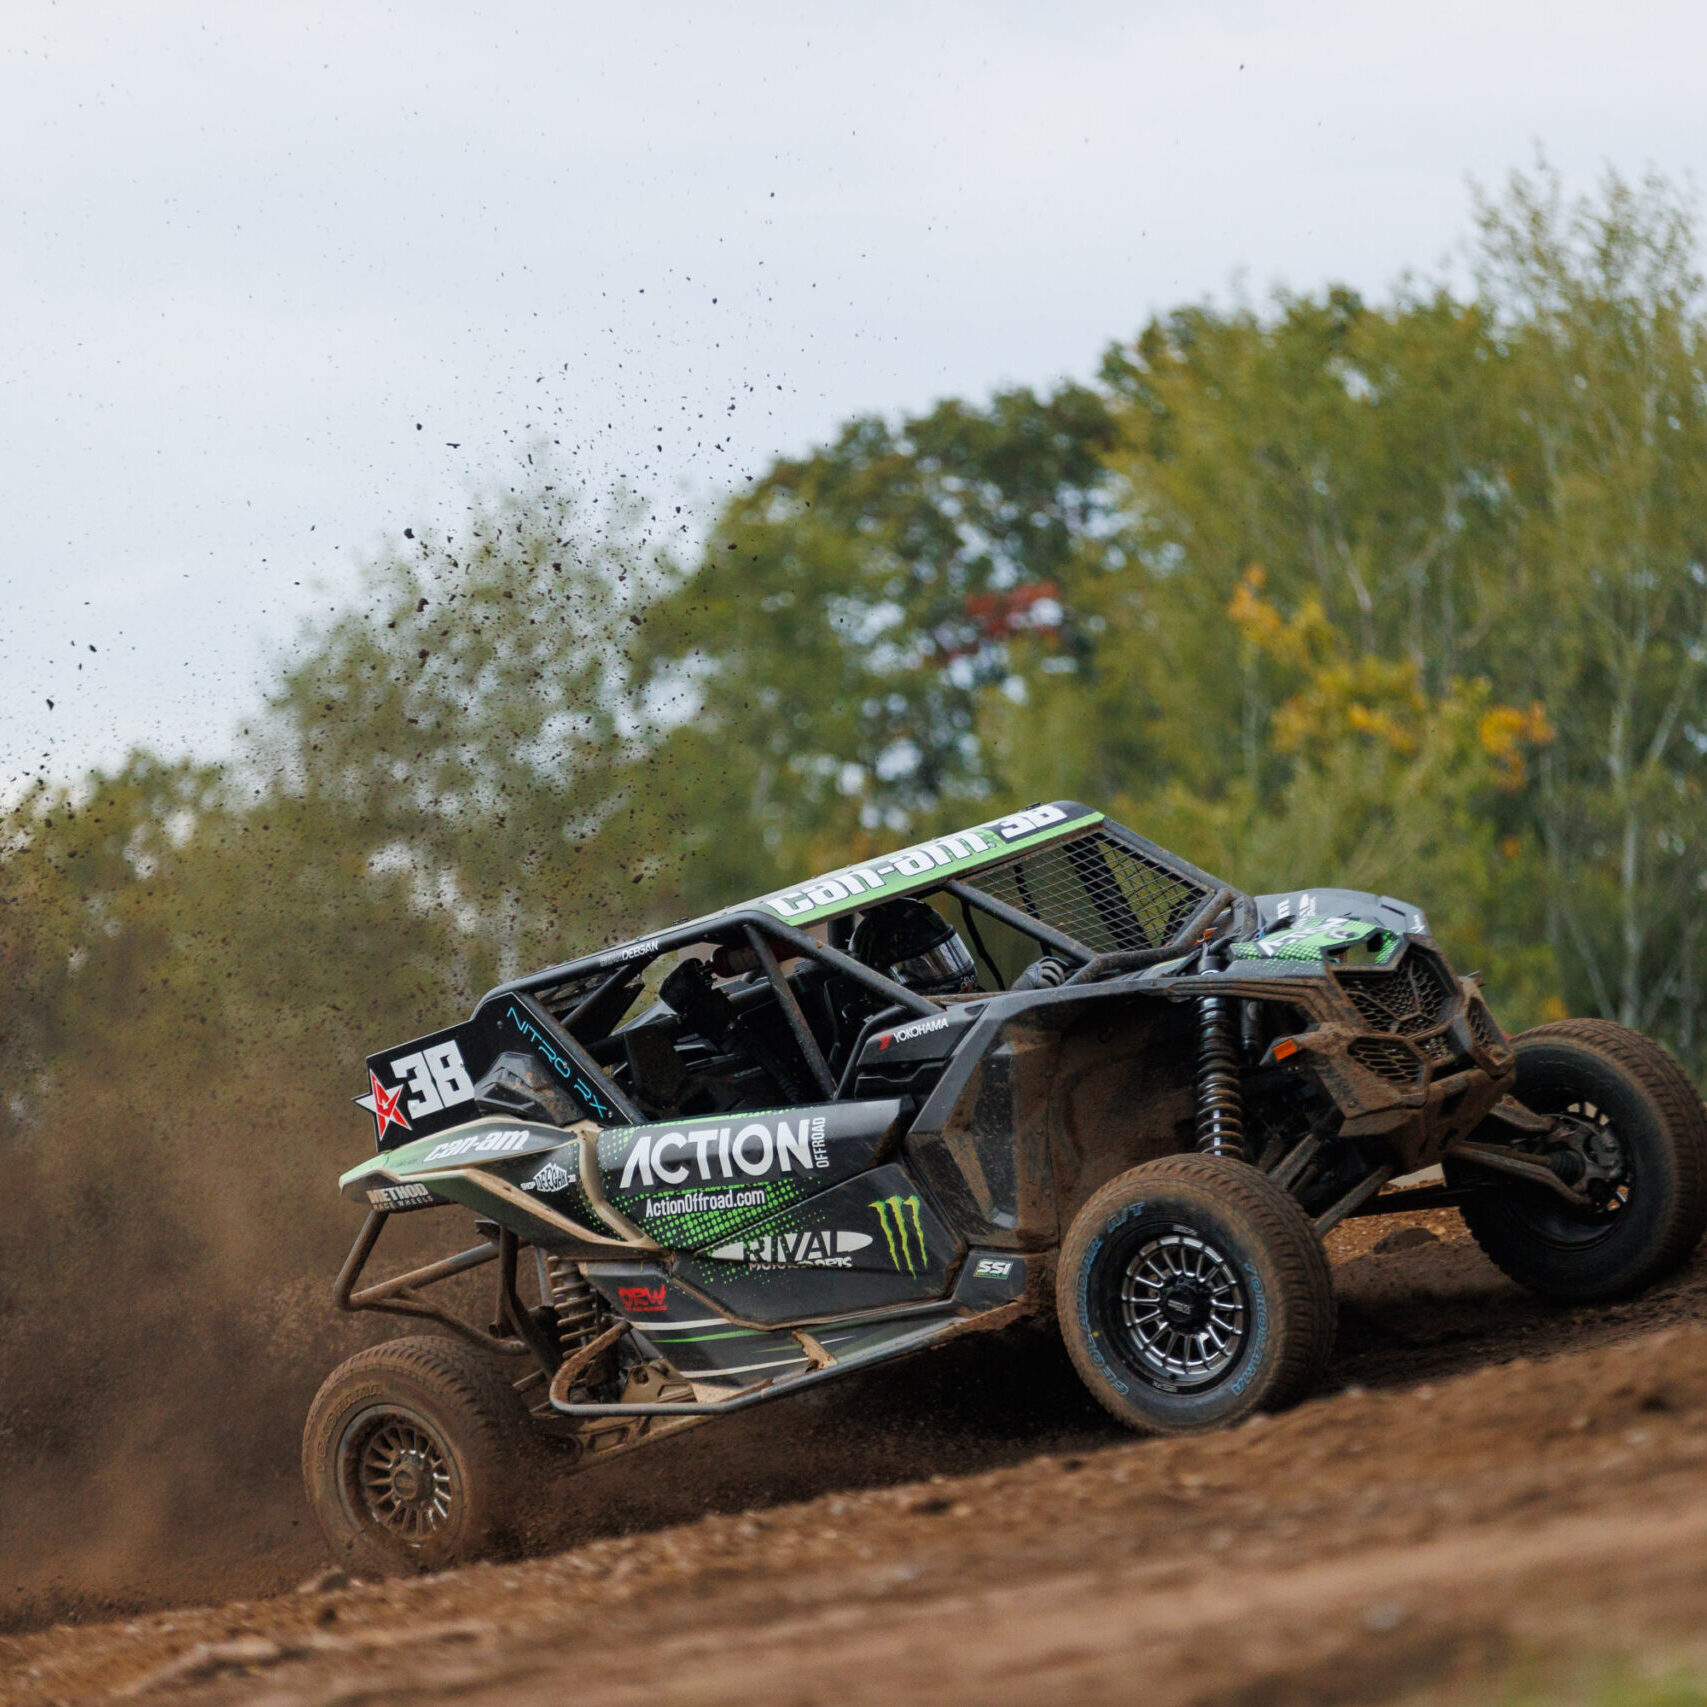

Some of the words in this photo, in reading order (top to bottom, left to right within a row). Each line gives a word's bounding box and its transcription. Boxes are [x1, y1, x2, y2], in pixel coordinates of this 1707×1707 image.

[765, 830, 991, 917] can-am
[622, 941, 659, 961] DEEGAN
[893, 1018, 949, 1043] YOKOHAMA
[507, 1007, 571, 1078] NITRO
[574, 1078, 608, 1119] RX
[390, 1040, 475, 1120] 38
[423, 1130, 529, 1162] can-am
[619, 1120, 813, 1189] ACTION
[814, 1116, 829, 1168] OFFROAD
[645, 1188, 766, 1217] ActionOffroad.com
[743, 1230, 849, 1263] RIVAL
[976, 1260, 1011, 1275] SSI
